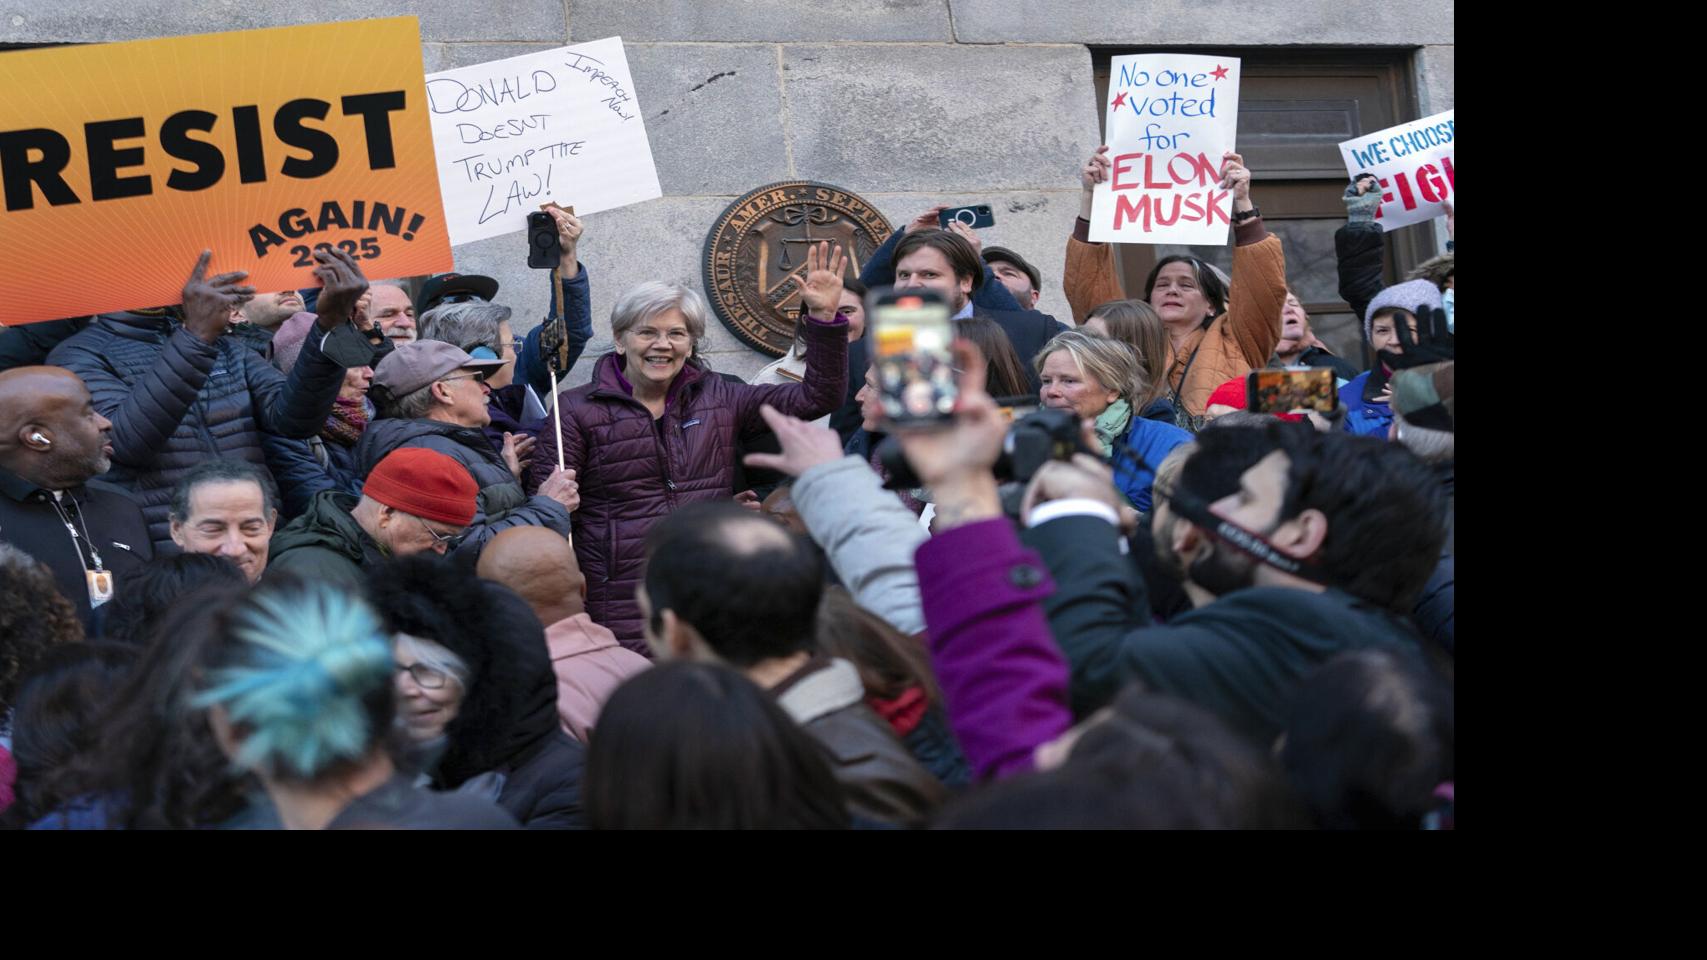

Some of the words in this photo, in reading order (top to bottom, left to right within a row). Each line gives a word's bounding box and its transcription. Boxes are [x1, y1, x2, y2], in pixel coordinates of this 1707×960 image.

[425, 70, 556, 114] DONALD
[1119, 62, 1150, 88] No
[1156, 70, 1207, 88] one
[1129, 87, 1216, 118] voted
[0, 90, 406, 212] RESIST
[1139, 123, 1190, 150] for
[1351, 140, 1390, 169] WE
[453, 149, 536, 183] TRUMP
[538, 140, 587, 160] THE
[1112, 152, 1228, 191] ELON
[478, 163, 552, 225] LAW!
[1113, 189, 1231, 233] MUSK
[248, 200, 425, 259] AGAIN!
